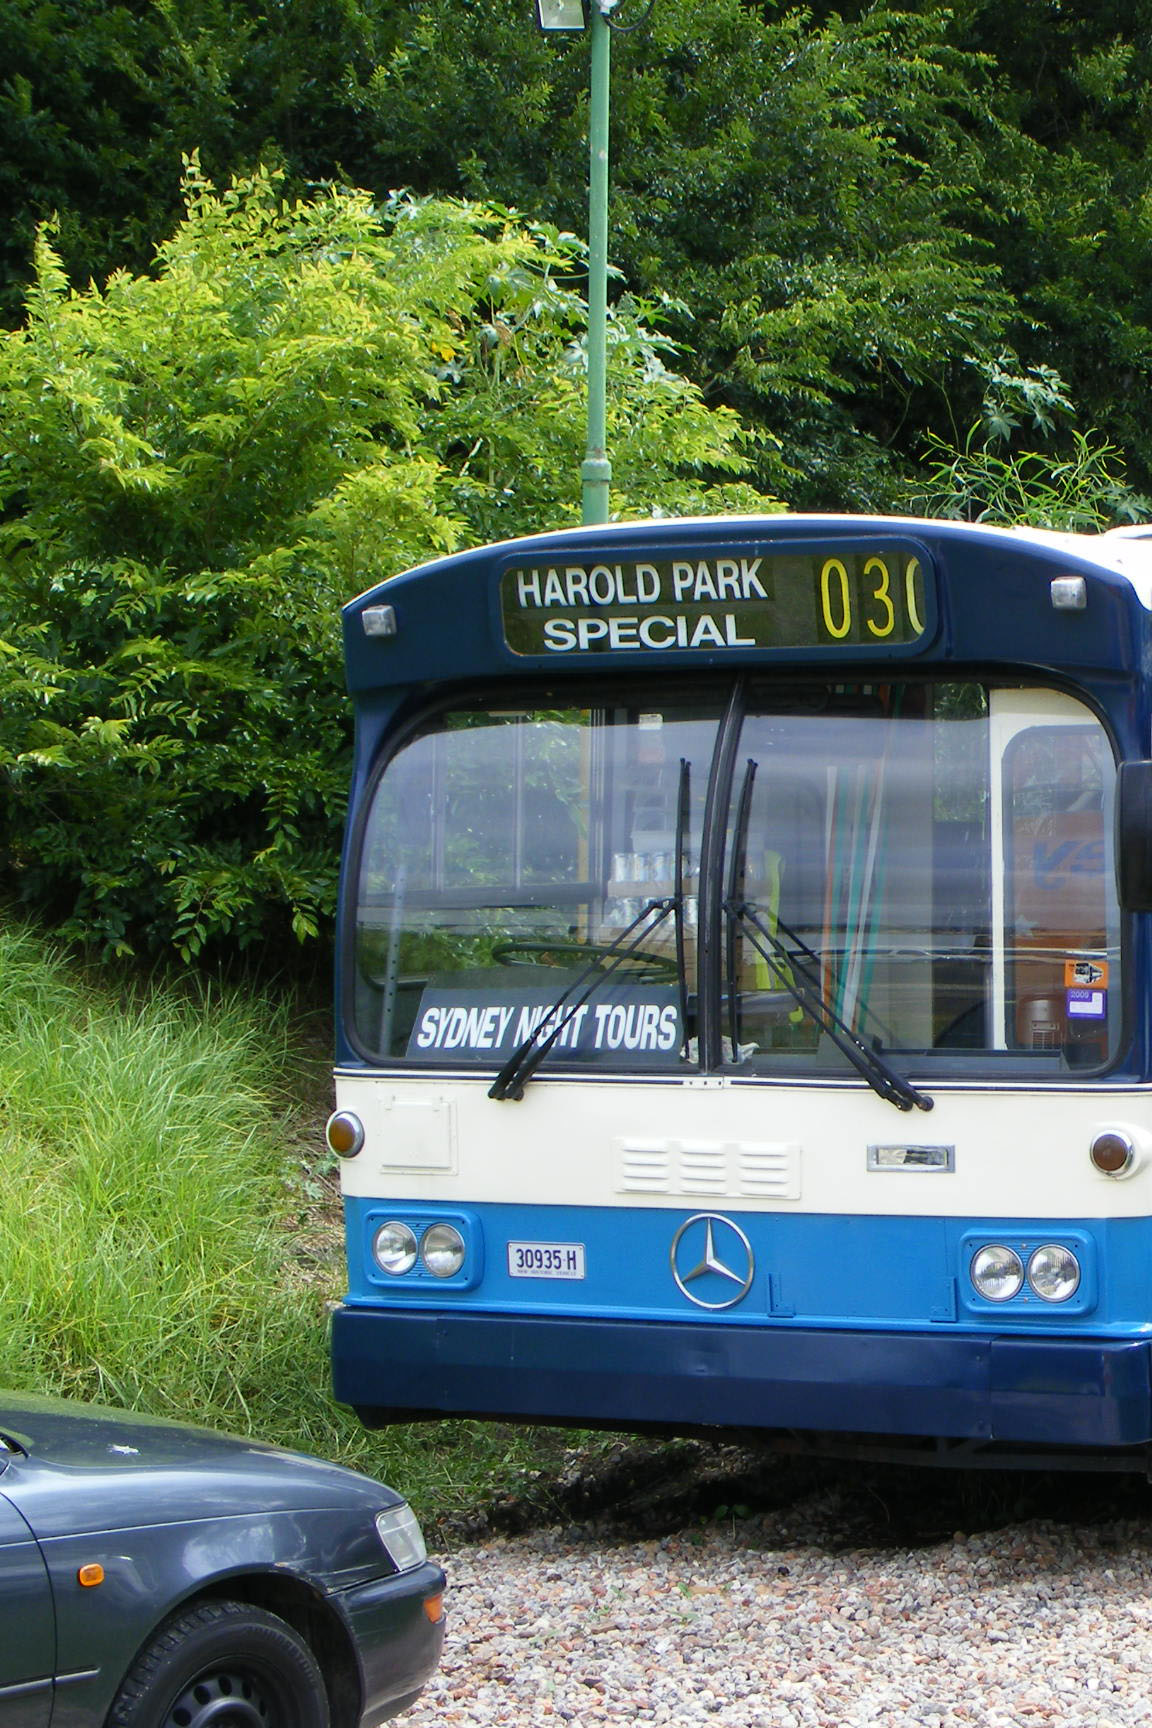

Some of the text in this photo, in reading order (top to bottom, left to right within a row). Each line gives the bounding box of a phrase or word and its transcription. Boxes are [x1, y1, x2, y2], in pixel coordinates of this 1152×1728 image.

[518, 558, 768, 607] HAROLD PARK
[543, 614, 756, 652] SPECIAL
[416, 1006, 514, 1048] SYDNEY
[594, 1004, 677, 1050] TOURS
[516, 1249, 561, 1269] 30935
